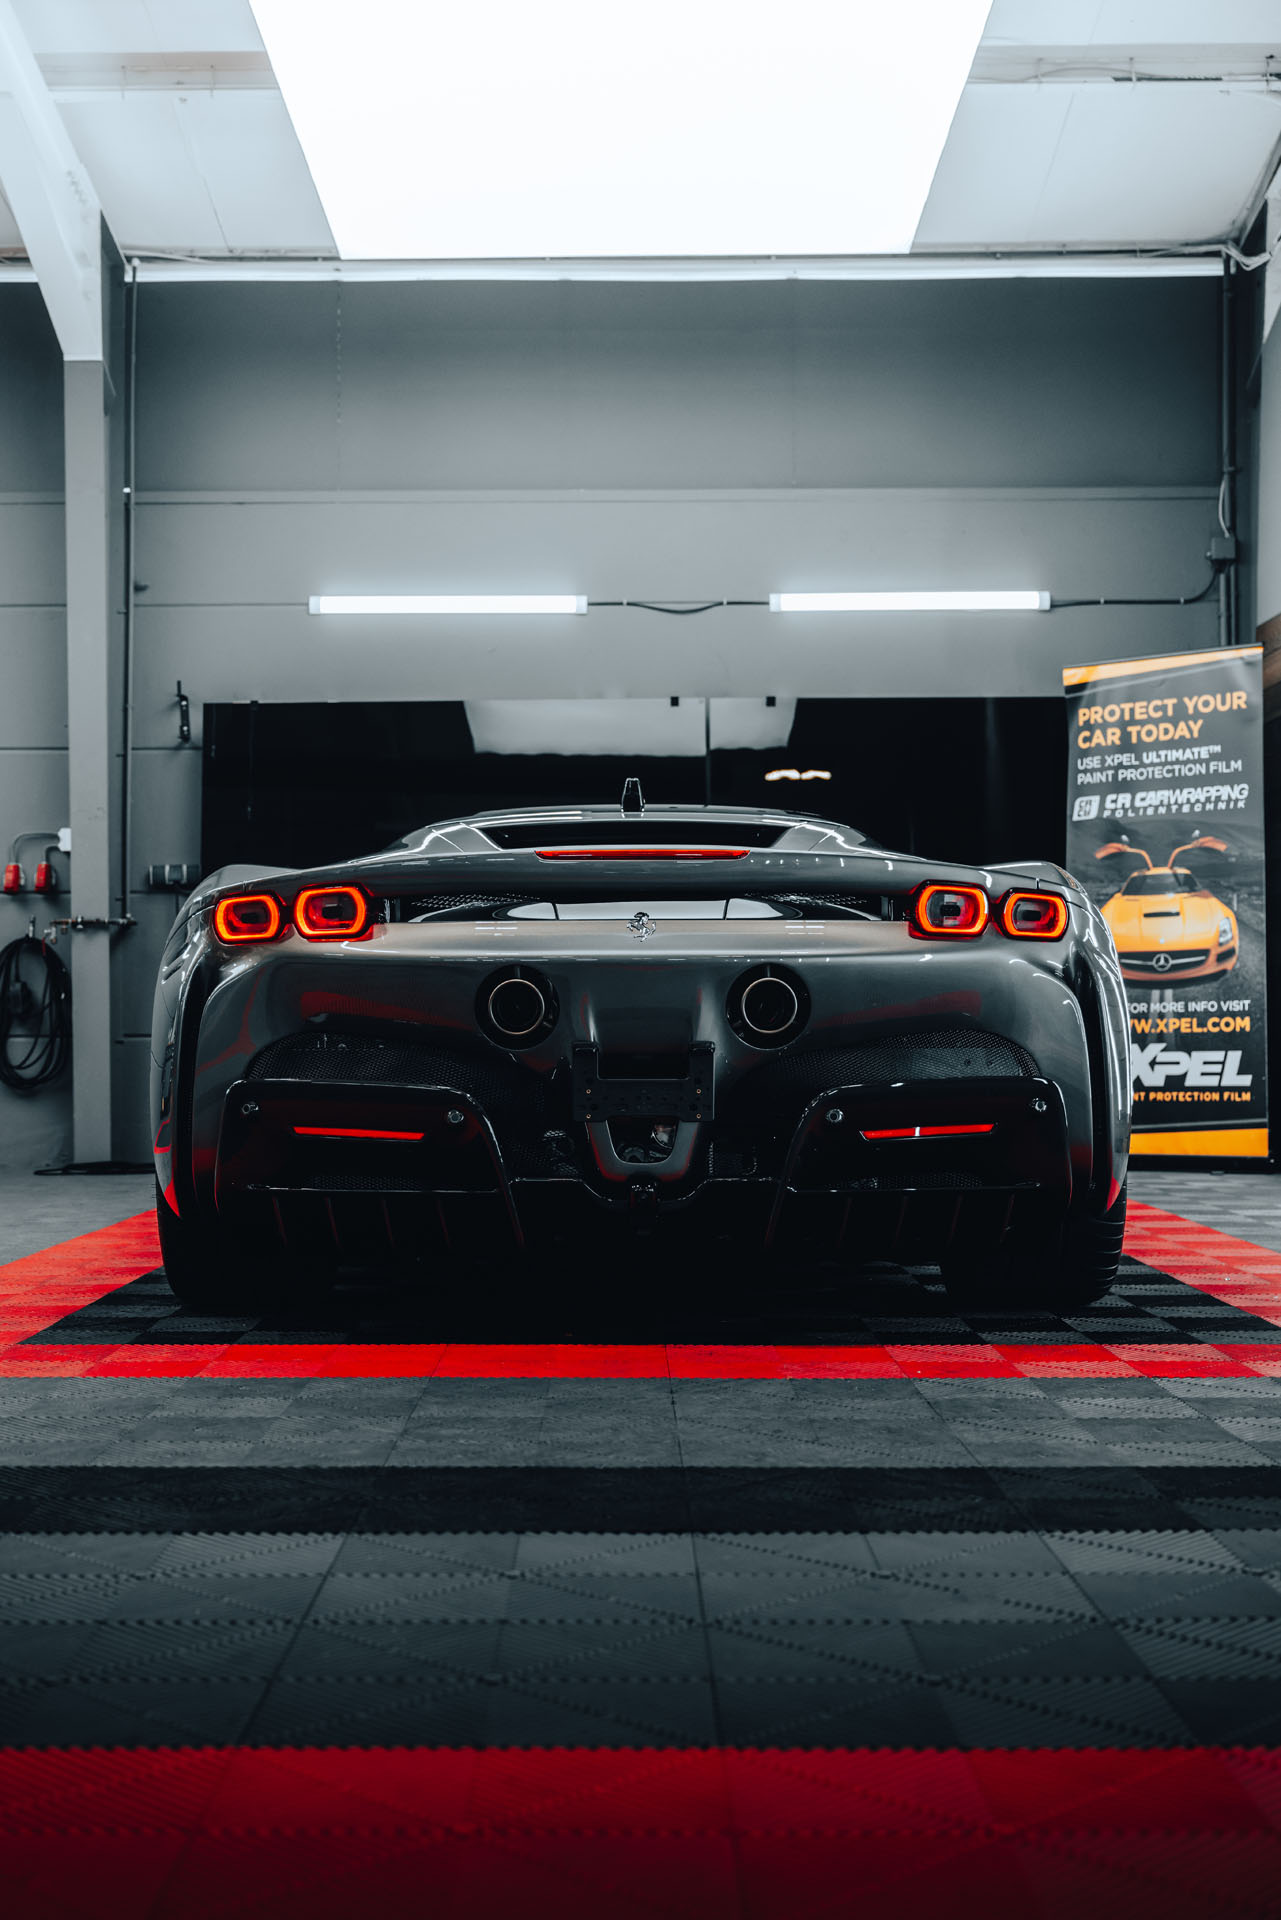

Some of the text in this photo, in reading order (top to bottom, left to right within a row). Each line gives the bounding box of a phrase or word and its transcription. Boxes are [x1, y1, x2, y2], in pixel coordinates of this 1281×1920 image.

[1078, 690, 1248, 727] PROTECT YOUR
[1077, 719, 1204, 749] CAR TODAY
[1077, 755, 1102, 770] USE
[1104, 752, 1139, 767] XPEL
[1077, 759, 1242, 786] PAINT PROTECTION FILM
[1150, 1001, 1185, 1013] MORE
[1187, 1000, 1218, 1012] INFO
[1220, 999, 1251, 1012] VISIT
[1131, 1042, 1253, 1087] XPEL
[1149, 1091, 1220, 1103] PROTECTION
[1223, 1090, 1251, 1102] FILM
